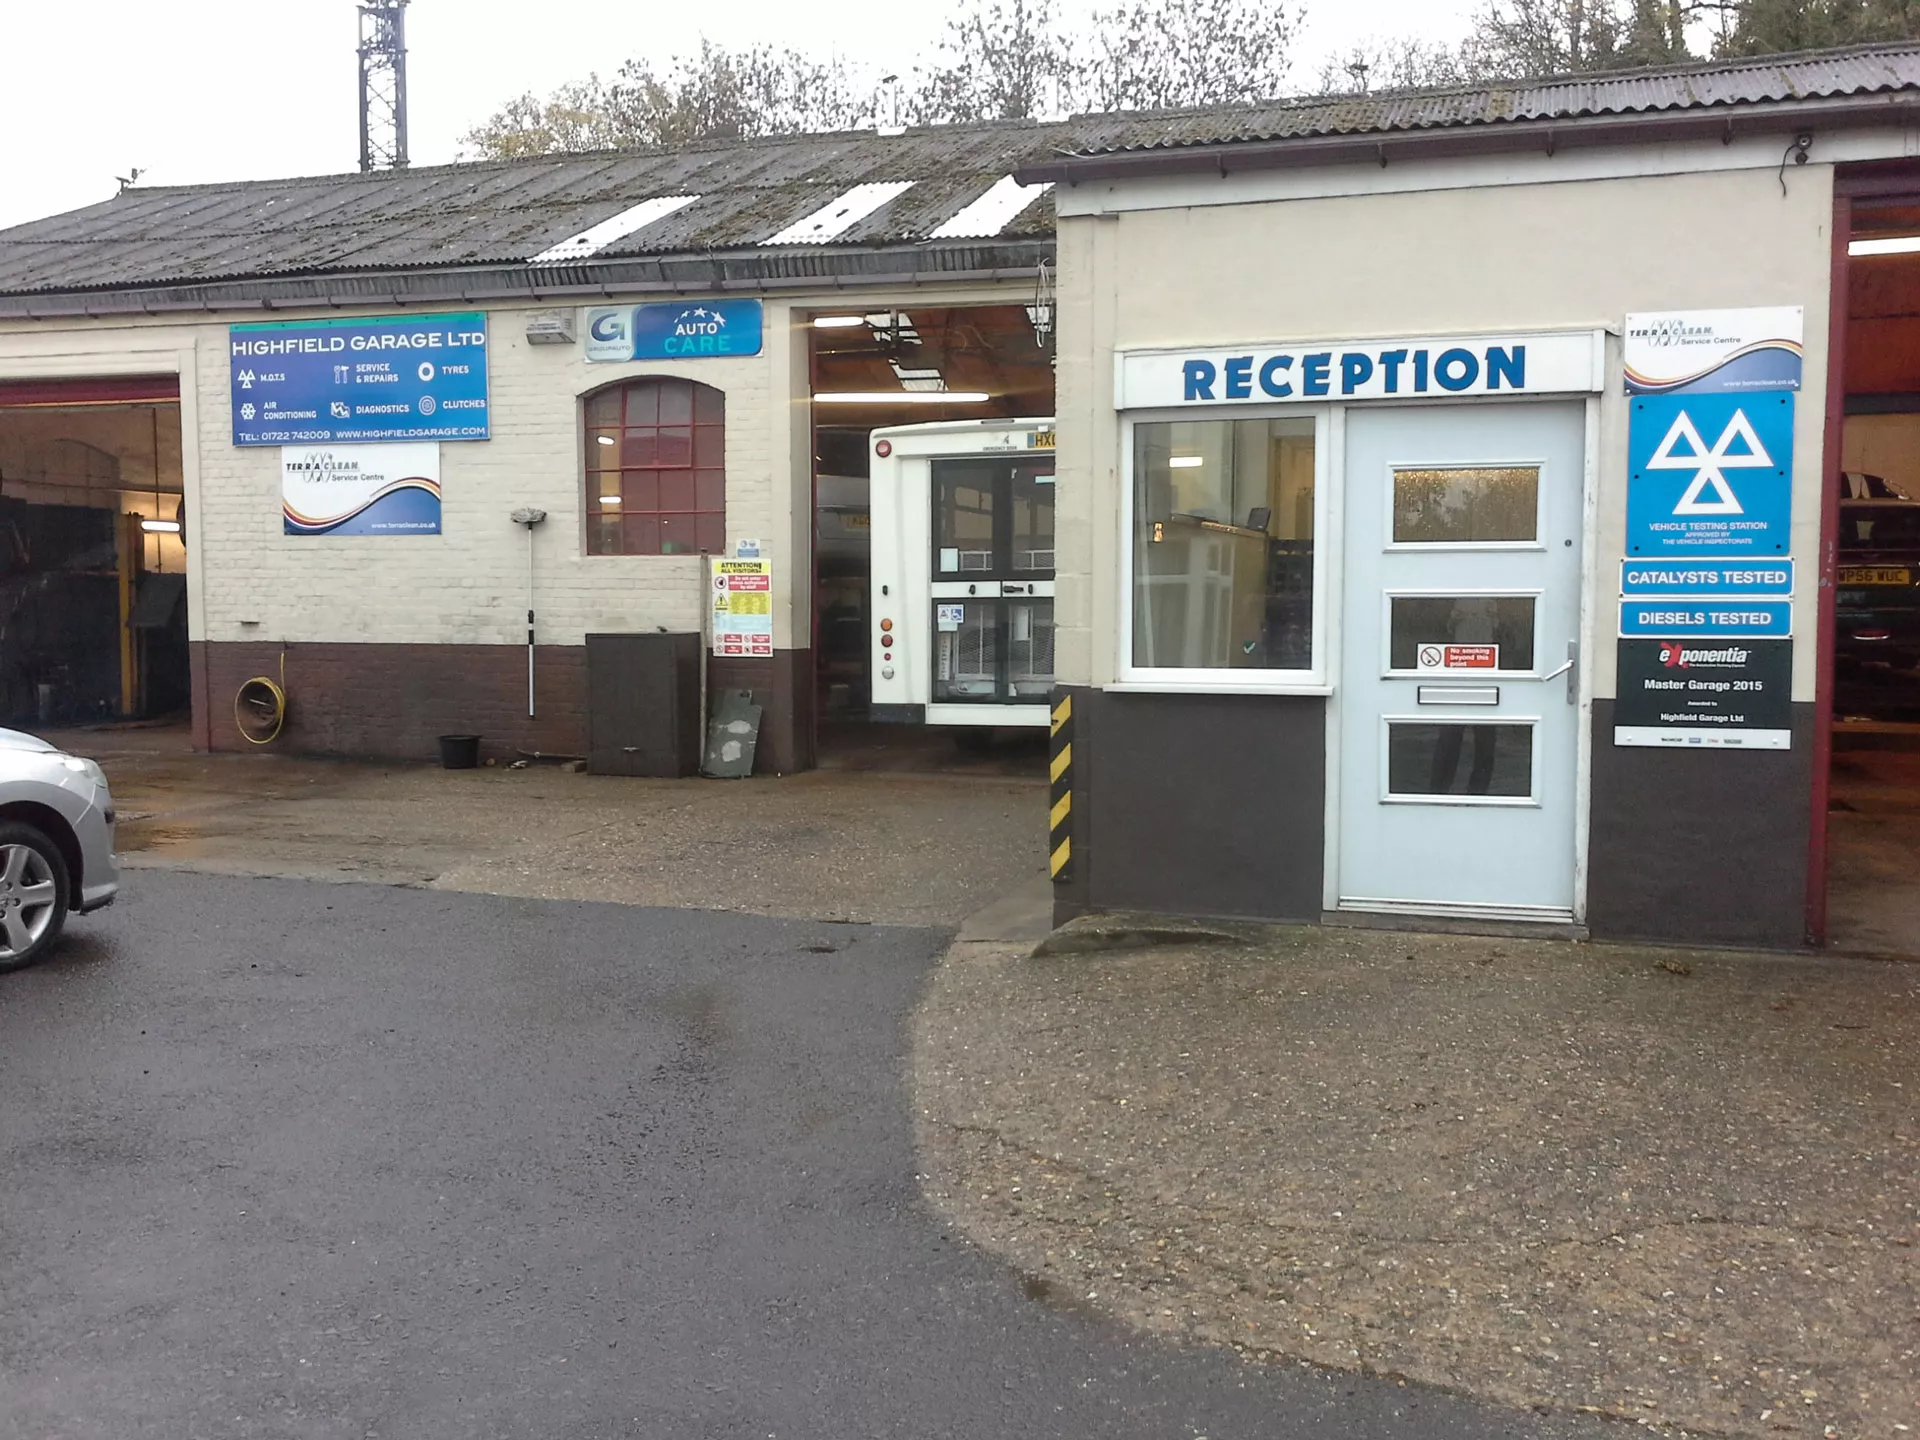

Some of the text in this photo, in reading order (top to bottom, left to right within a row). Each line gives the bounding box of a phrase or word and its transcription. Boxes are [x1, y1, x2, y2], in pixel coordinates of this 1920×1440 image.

[675, 322, 718, 336] AUTO
[1629, 326, 1712, 337] TERRACLEAN
[232, 332, 485, 356] HIGHFIELD GARAGE LTD
[664, 335, 731, 353] CARE
[1681, 336, 1741, 346] Service Centre
[356, 363, 390, 372] SERVICE
[442, 365, 469, 375] TYRES
[1183, 345, 1526, 400] RECEPTION
[356, 374, 399, 383] & REPAIRS
[264, 401, 277, 410] AIR
[356, 404, 410, 414] DIAGNOSTICS
[442, 400, 486, 410] CLUTCHES
[264, 410, 317, 420] CONDITIONING
[239, 430, 331, 441] TEL: 01722 742009
[336, 427, 486, 439] WWW.HIGHFIELDGARAGE.COM
[286, 461, 360, 471] TERRACLEAN
[331, 473, 385, 482] Service Centre
[371, 521, 436, 529] www.terraclean.co.uk
[1649, 521, 1768, 531] VEHICLE TESTING STATION
[1627, 570, 1787, 585] CATALYSTS TESTED
[1638, 612, 1772, 625] DIESELS TESTED
[1462, 647, 1490, 655] smoking
[1644, 679, 1763, 692] Master Garage 2015
[1660, 713, 1697, 722] Highfield
[1698, 714, 1729, 723] Garage
